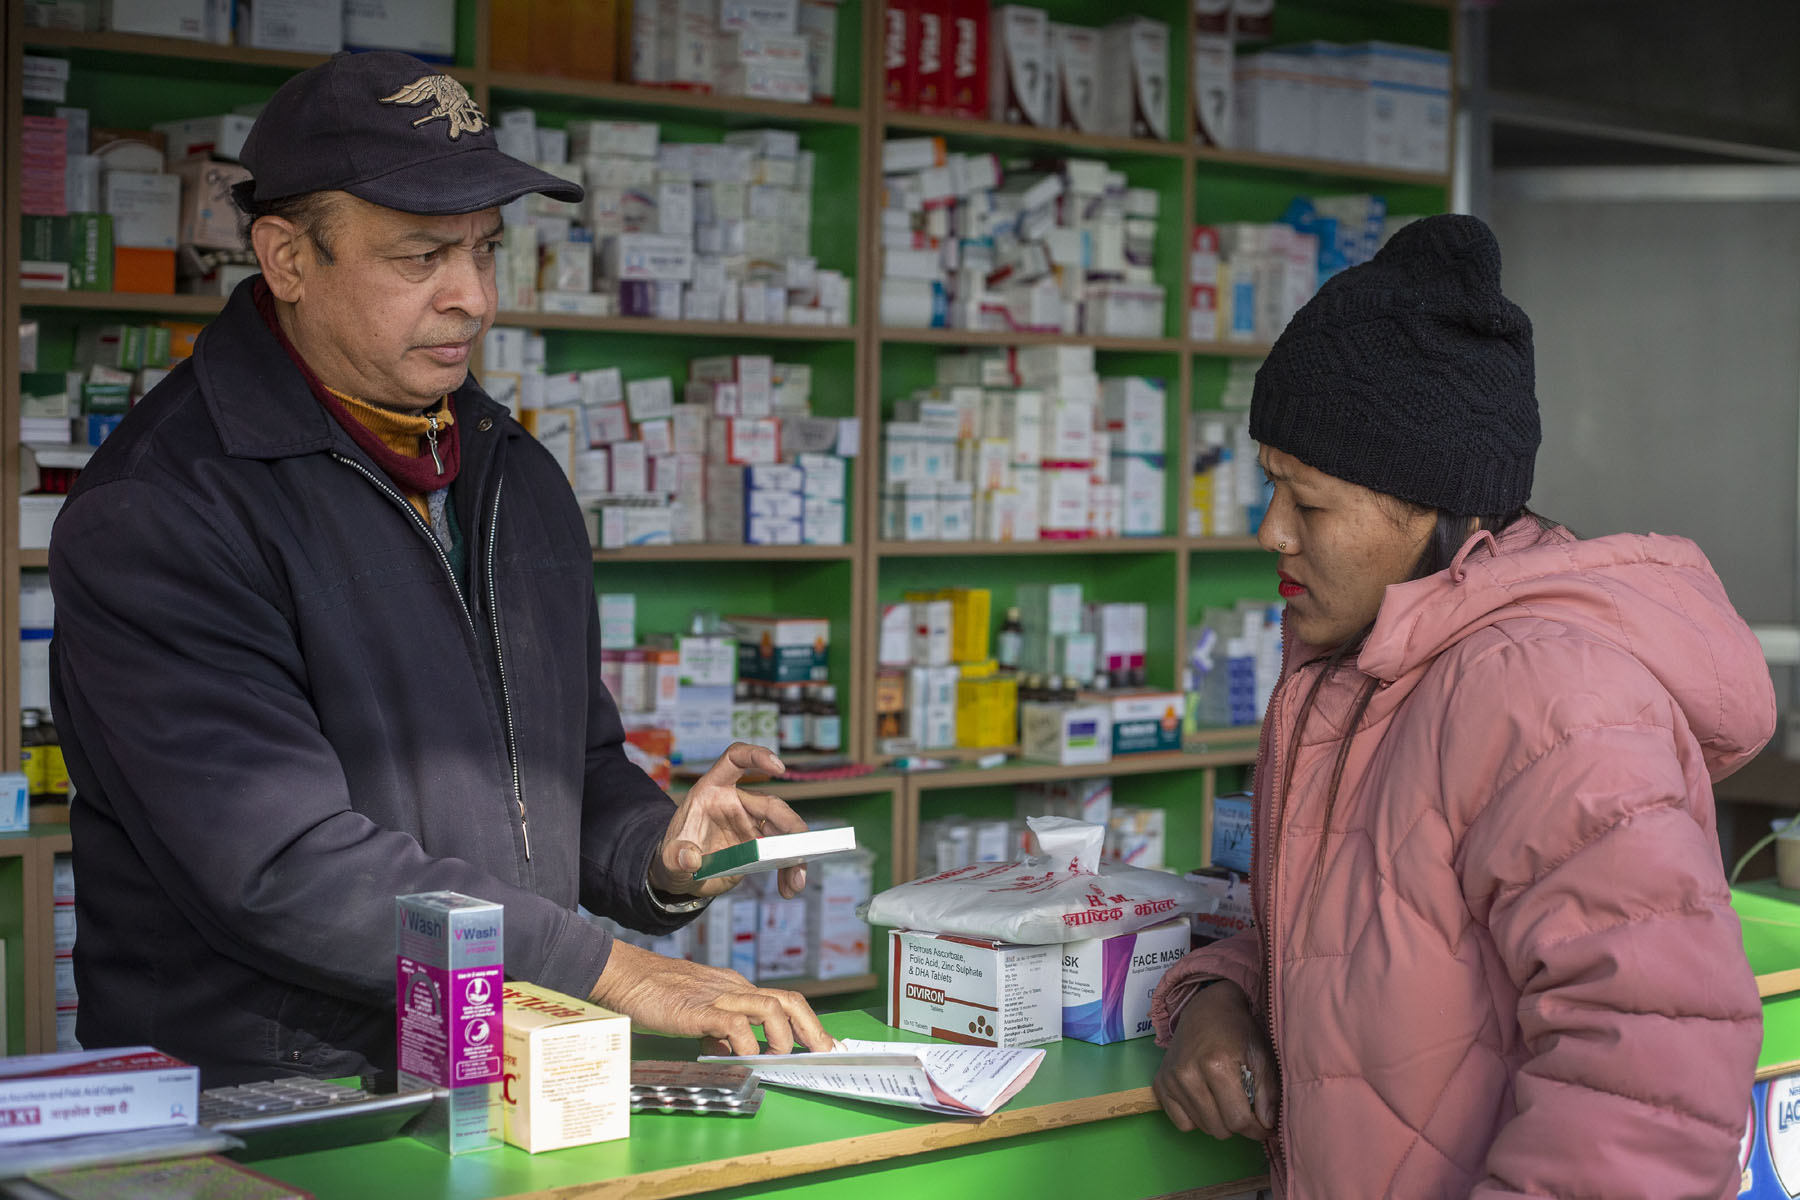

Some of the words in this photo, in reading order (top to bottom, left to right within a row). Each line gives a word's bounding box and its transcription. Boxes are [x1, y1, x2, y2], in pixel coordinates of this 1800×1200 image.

[909, 942, 932, 955] Ferrous
[933, 948, 966, 964] Ascorbate,
[1133, 953, 1158, 967] FACE
[1160, 947, 1186, 962] MASK
[909, 954, 924, 965] Folic
[925, 957, 940, 970] Acid,
[941, 961, 954, 972] Zinc
[955, 964, 983, 978] Sulphate
[909, 966, 914, 975] &
[915, 967, 929, 978] DHA
[931, 970, 952, 983] Tablets
[907, 985, 944, 1003] DIVIRON
